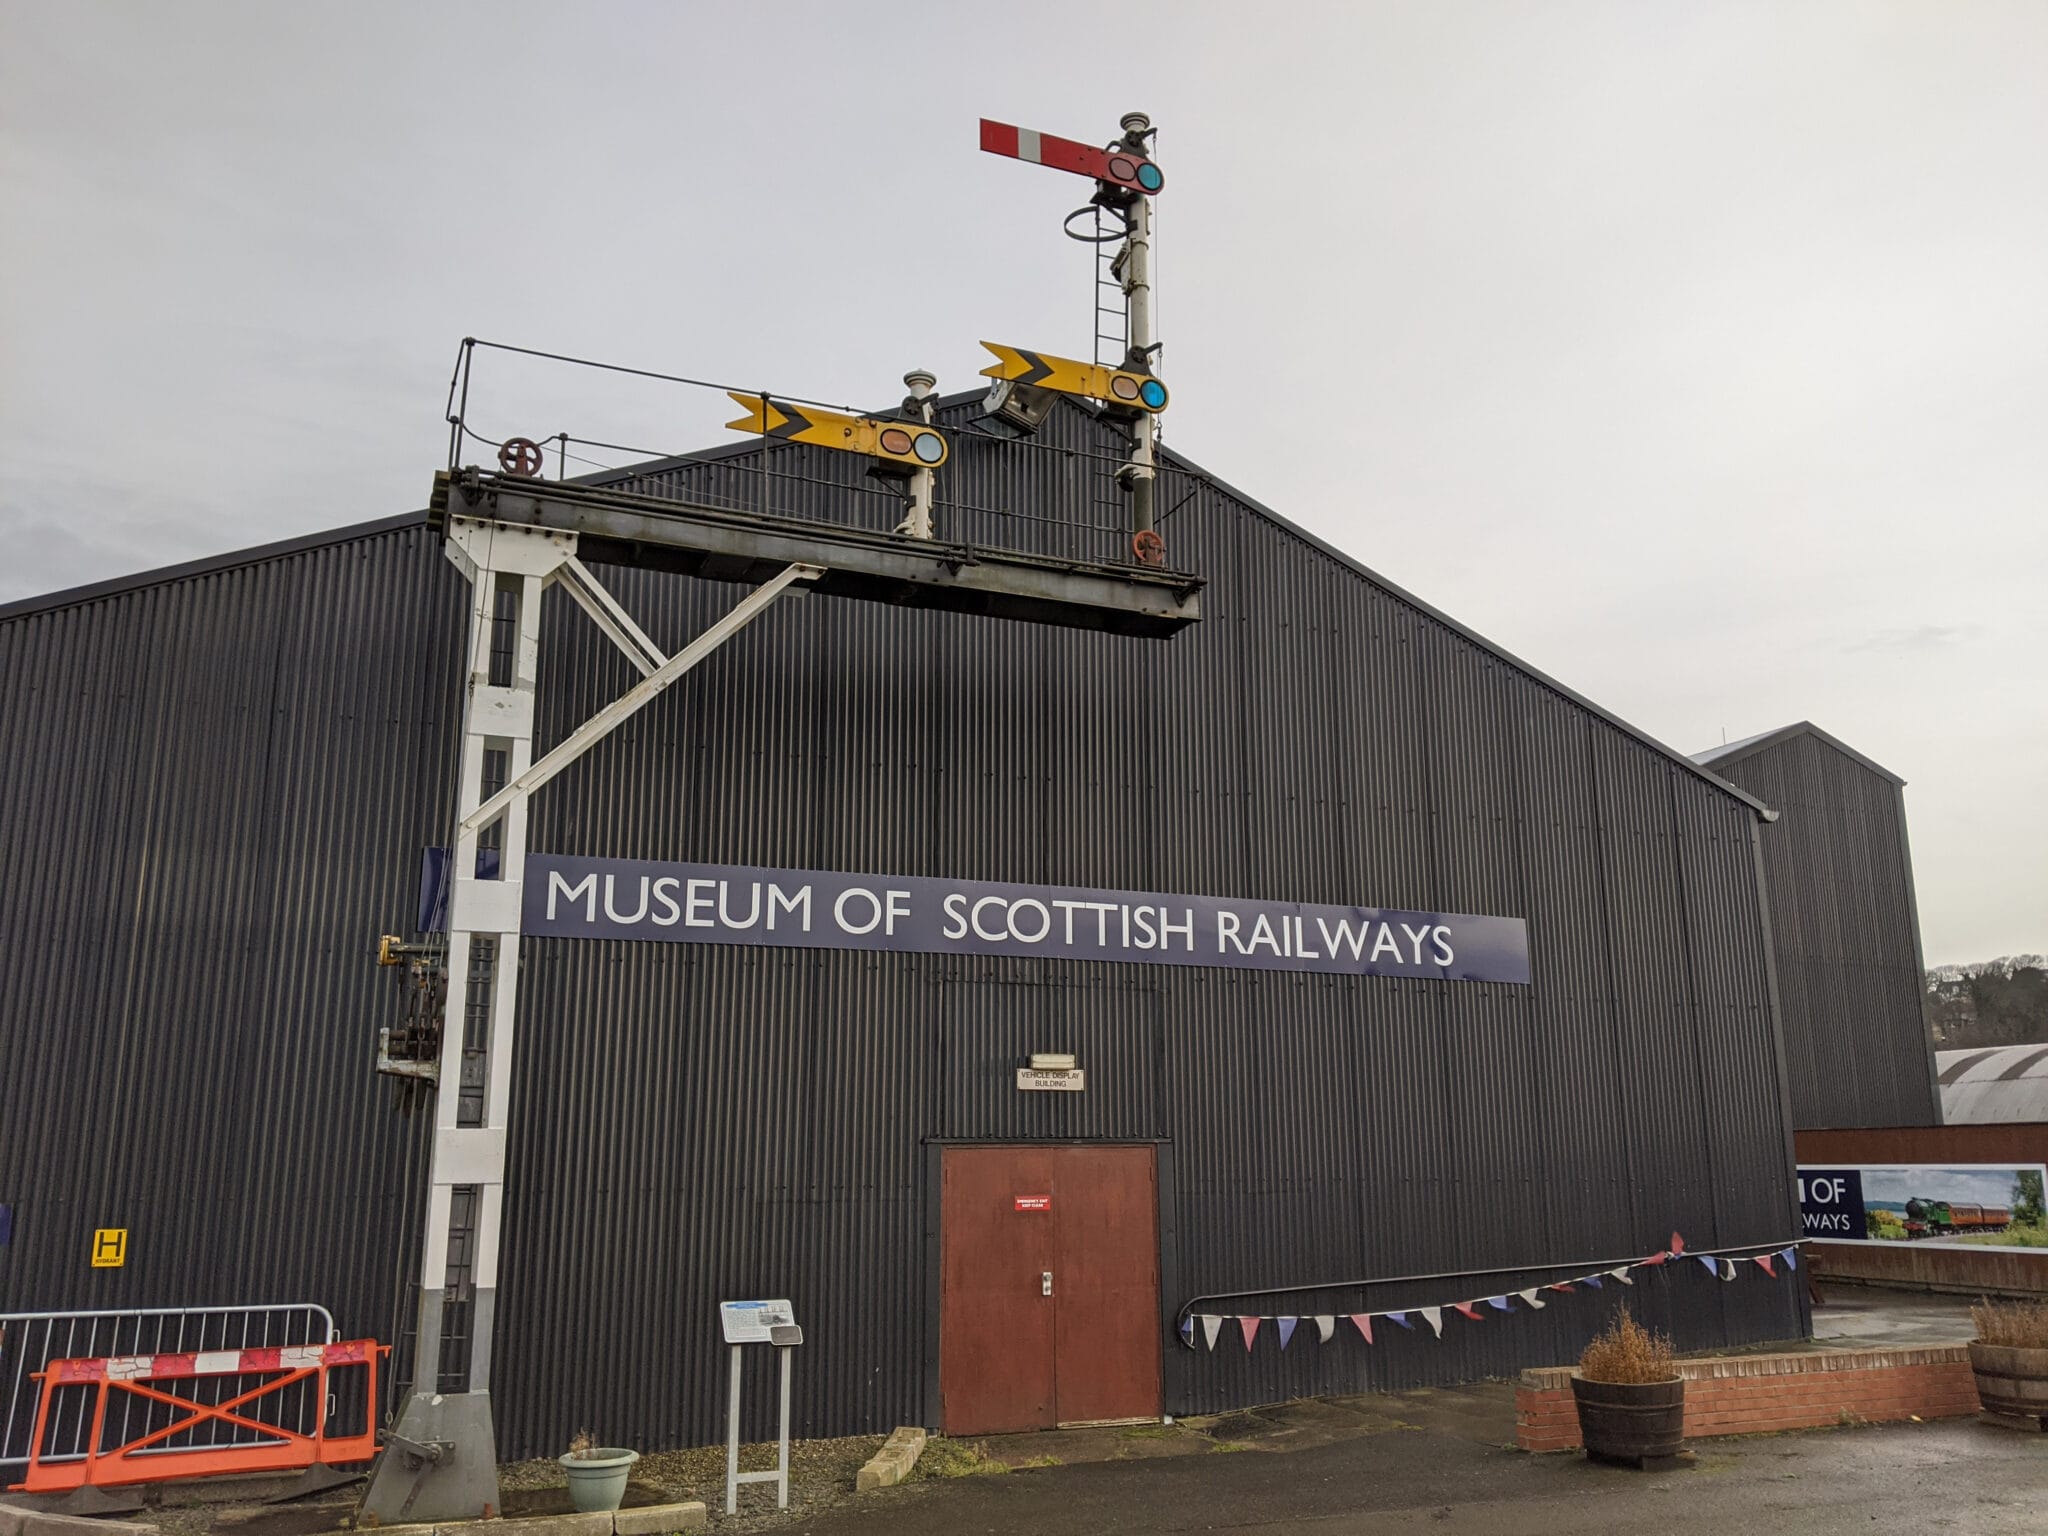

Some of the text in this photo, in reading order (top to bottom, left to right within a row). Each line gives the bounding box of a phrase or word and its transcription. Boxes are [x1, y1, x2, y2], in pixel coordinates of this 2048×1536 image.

[546, 870, 1455, 968] MUSEUM OF SCOTTISH RAILWAYS
[1021, 1071, 1080, 1080] VEHICLE DISPLAY
[1035, 1080, 1067, 1088] BUILDING
[1811, 1178, 1846, 1203] OF
[1802, 1213, 1851, 1231] WAYS
[97, 1231, 123, 1257] H
